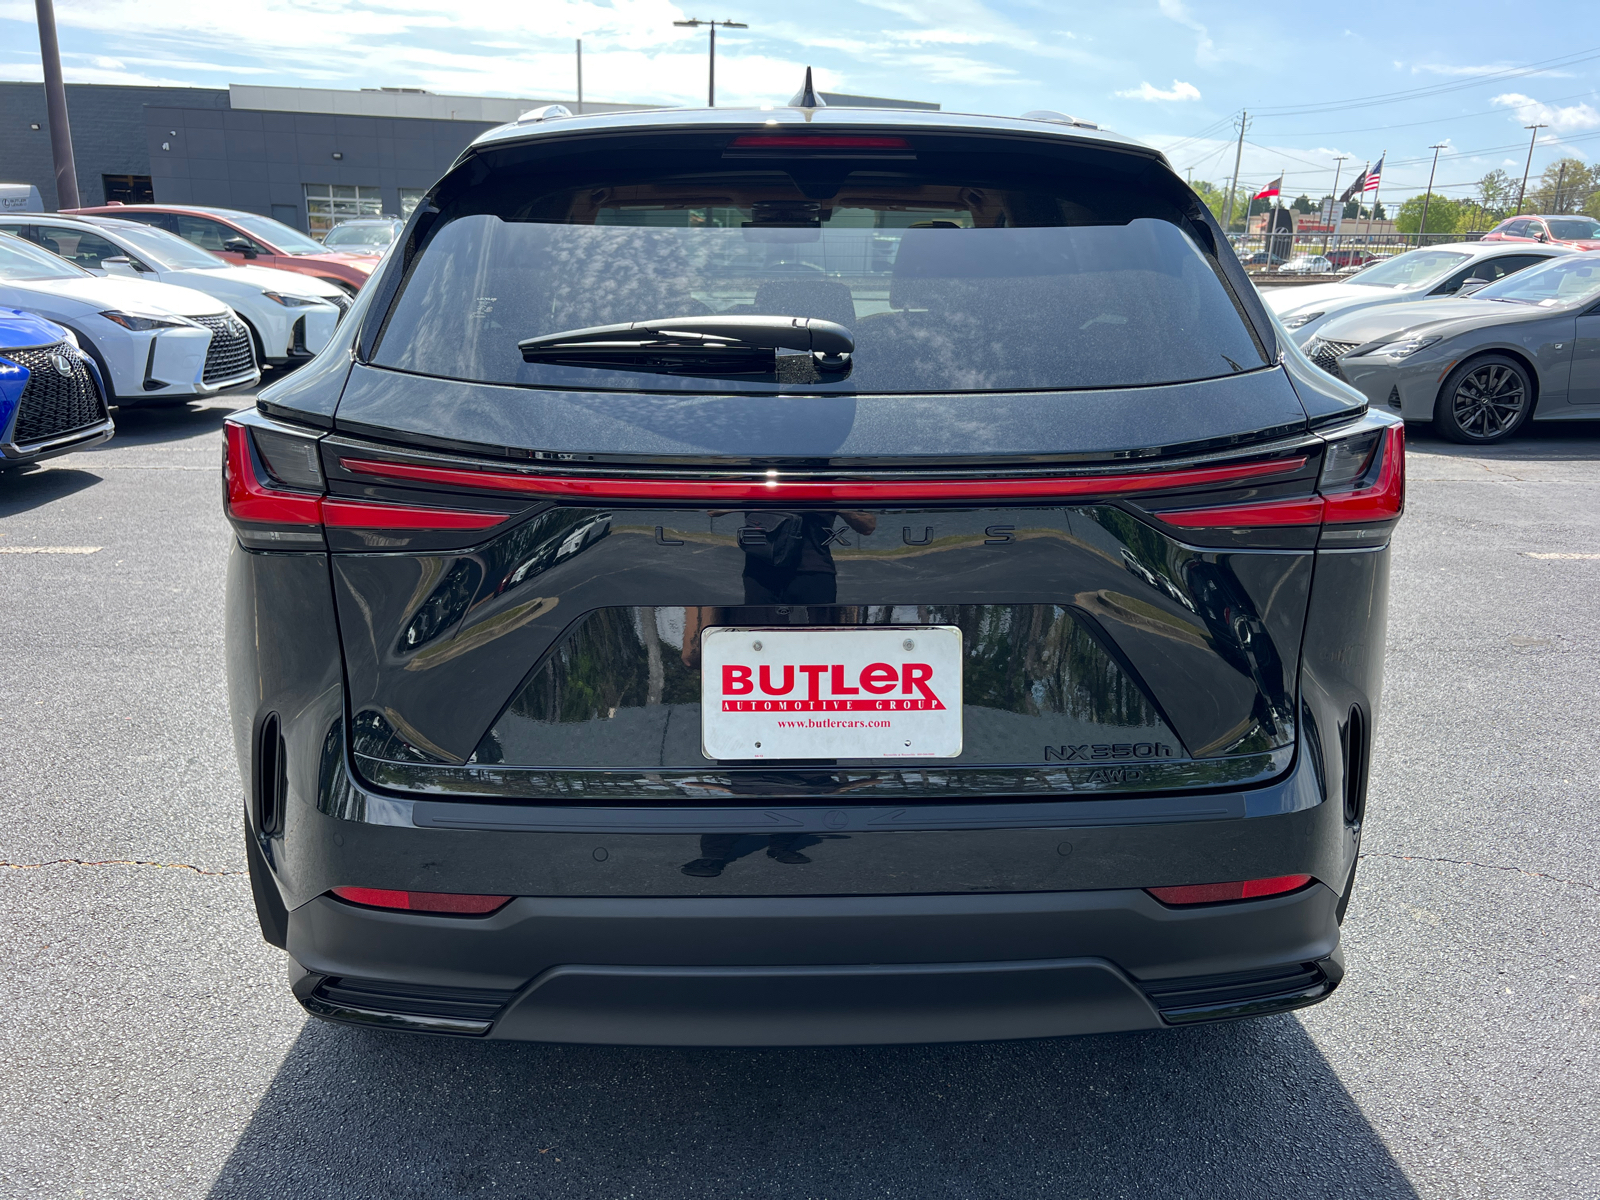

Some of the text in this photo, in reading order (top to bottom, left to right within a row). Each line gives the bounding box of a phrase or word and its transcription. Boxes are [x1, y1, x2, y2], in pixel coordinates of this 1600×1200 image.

[654, 525, 1016, 546] LEXUS
[723, 700, 938, 711] AUTOMOTIVE GROUP
[777, 718, 891, 729] www.butlercars.com
[1045, 742, 1174, 761] NX350h
[1086, 769, 1143, 783] AWD
